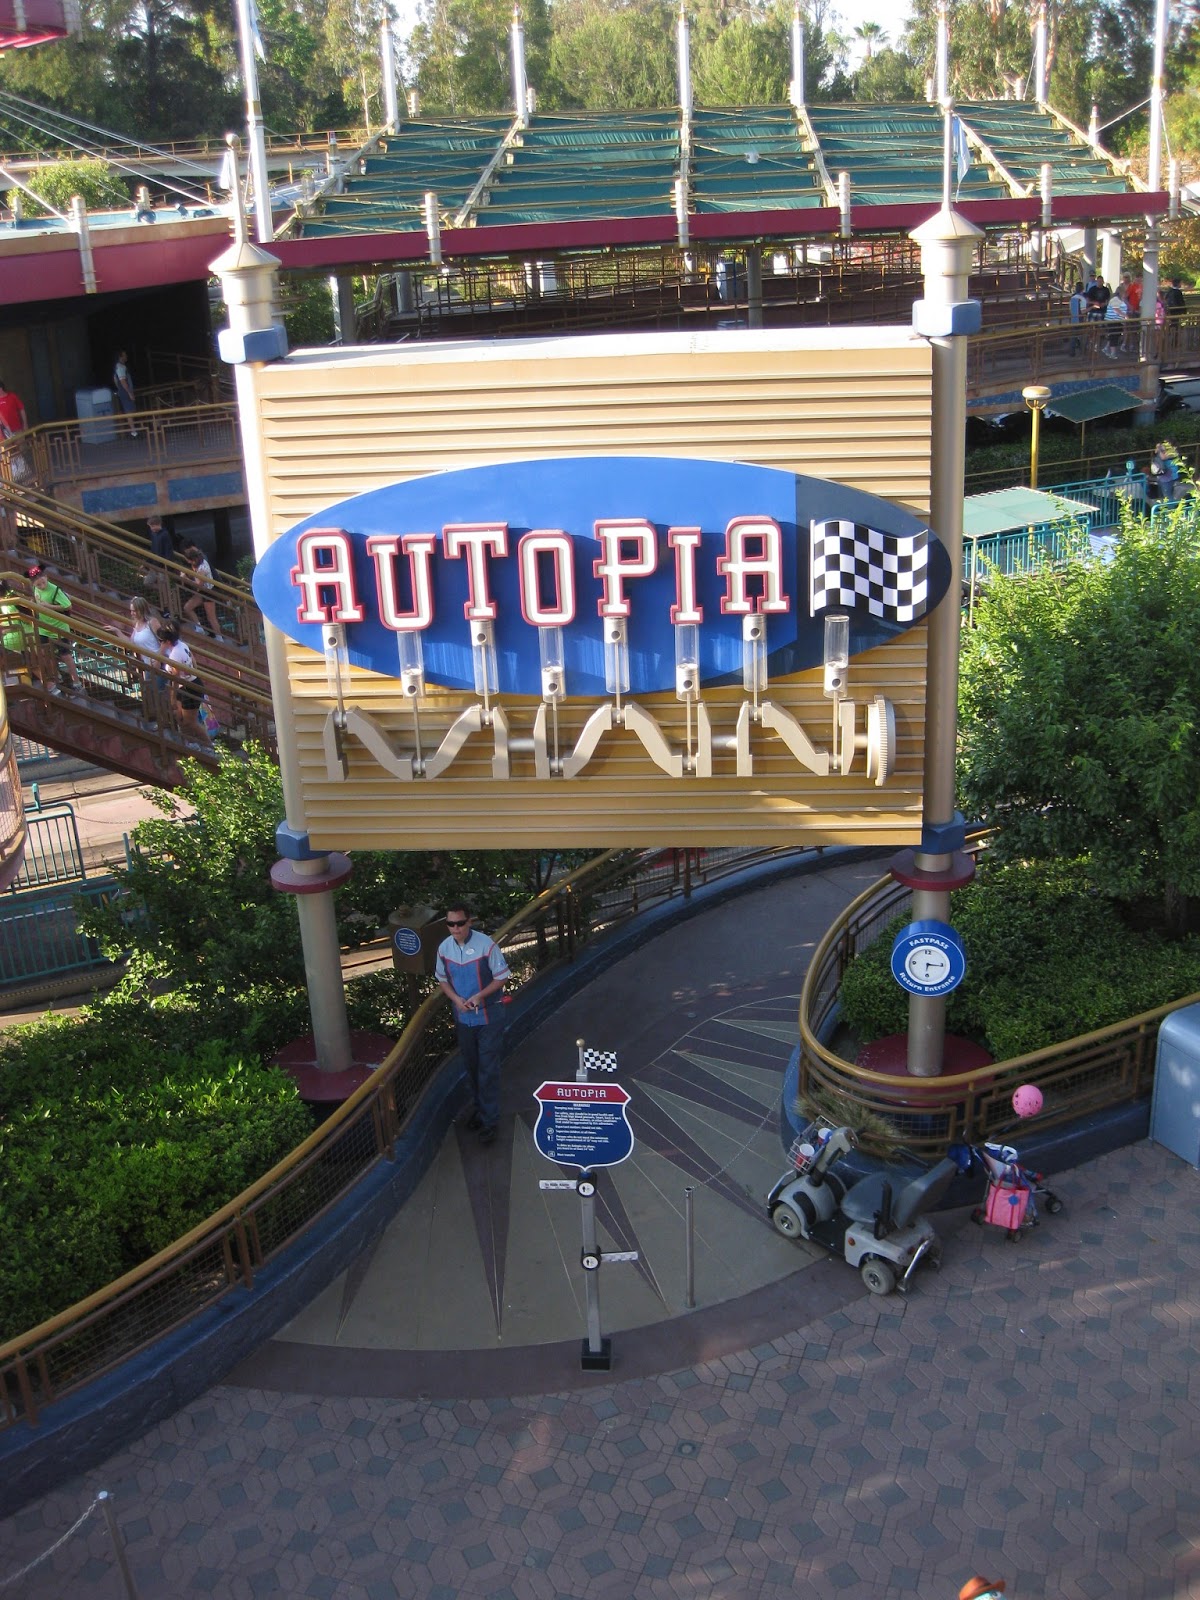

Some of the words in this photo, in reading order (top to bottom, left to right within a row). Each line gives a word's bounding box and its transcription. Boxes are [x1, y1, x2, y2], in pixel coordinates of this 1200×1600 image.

[290, 515, 790, 631] AUTOPIA
[909, 938, 949, 950] FASTPASS
[899, 972, 923, 991] Return
[924, 975, 956, 992] Entrance
[557, 1088, 607, 1098] AUTOPIA
